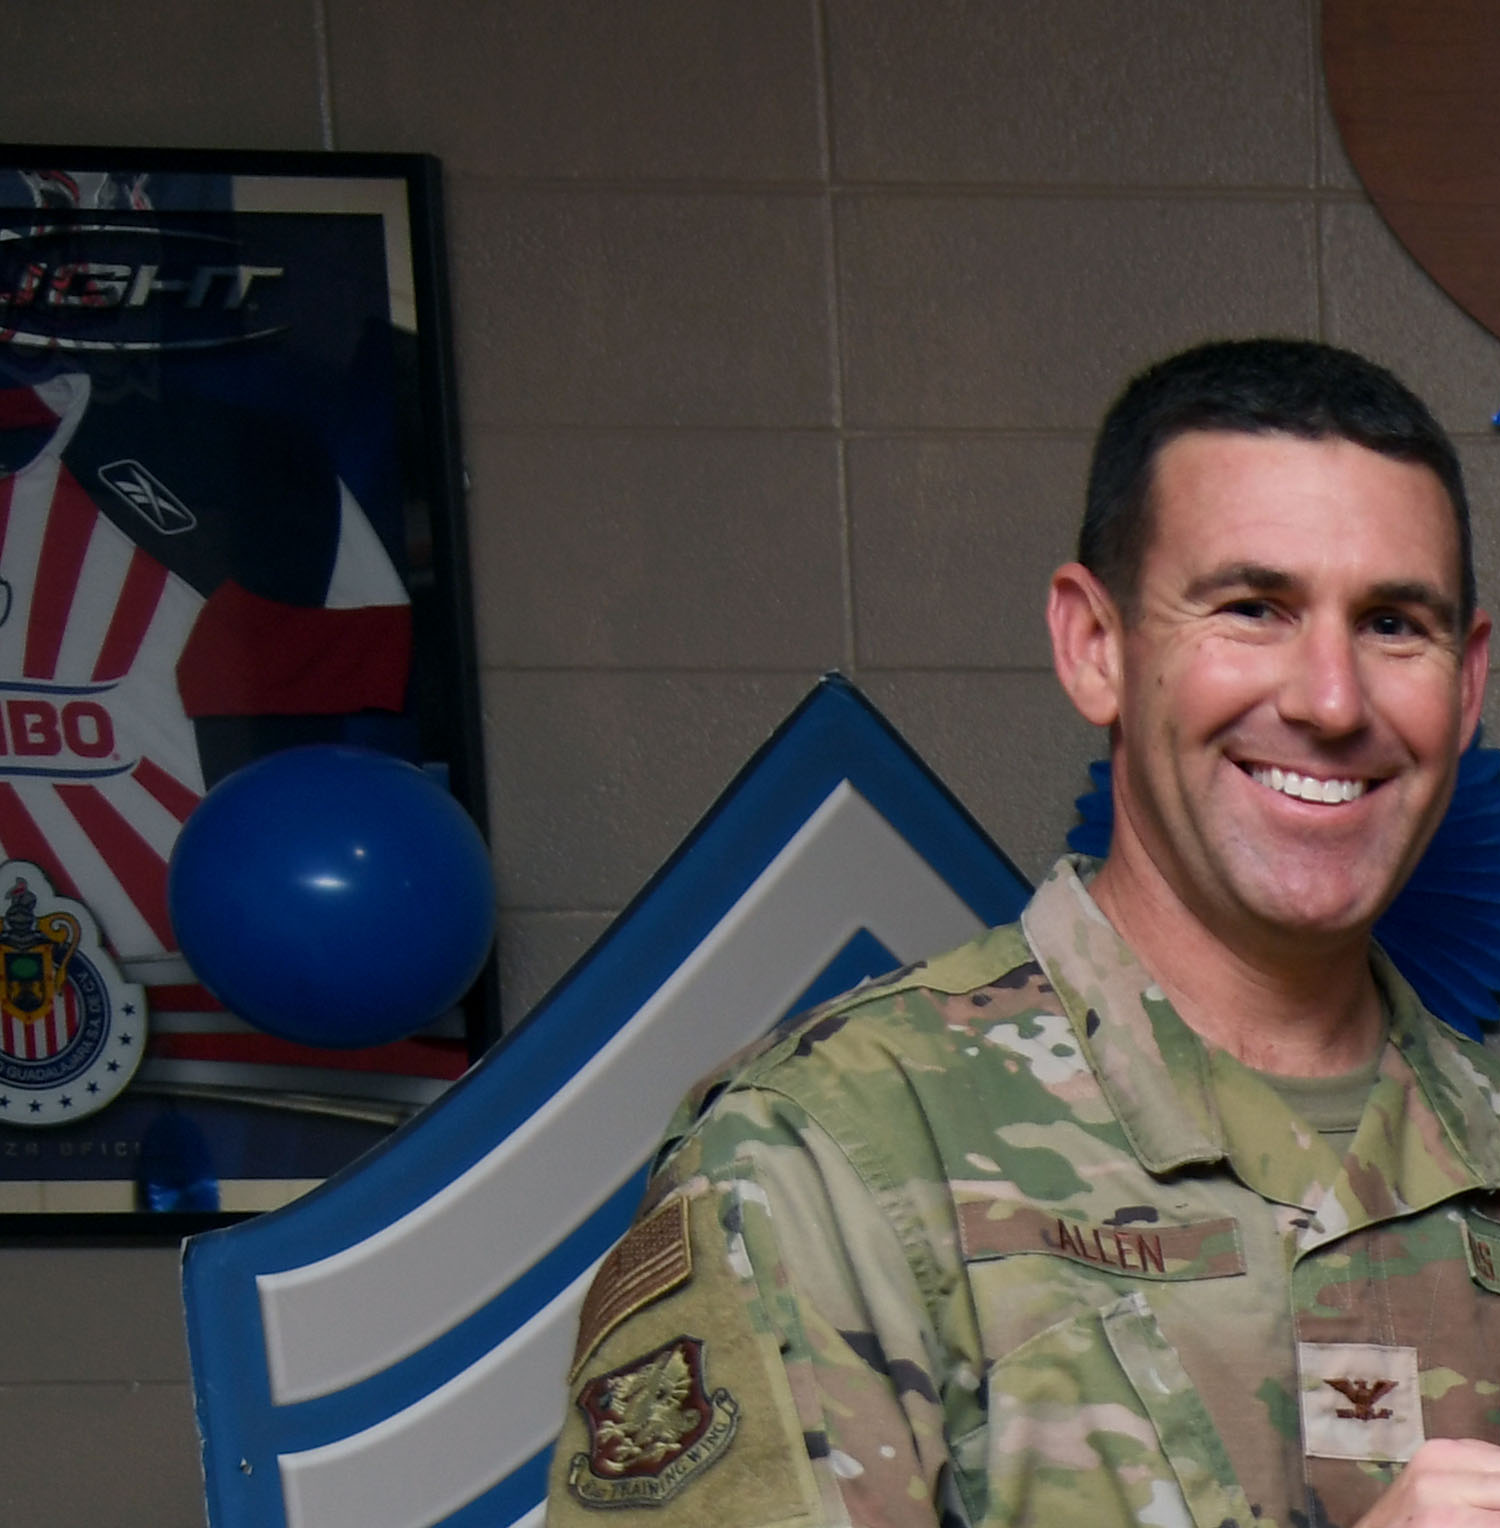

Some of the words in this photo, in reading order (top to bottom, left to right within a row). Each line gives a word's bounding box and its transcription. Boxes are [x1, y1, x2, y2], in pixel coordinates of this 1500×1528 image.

[0, 262, 284, 306] IGHT
[0, 699, 116, 759] BO
[1057, 1217, 1166, 1273] ALLEN
